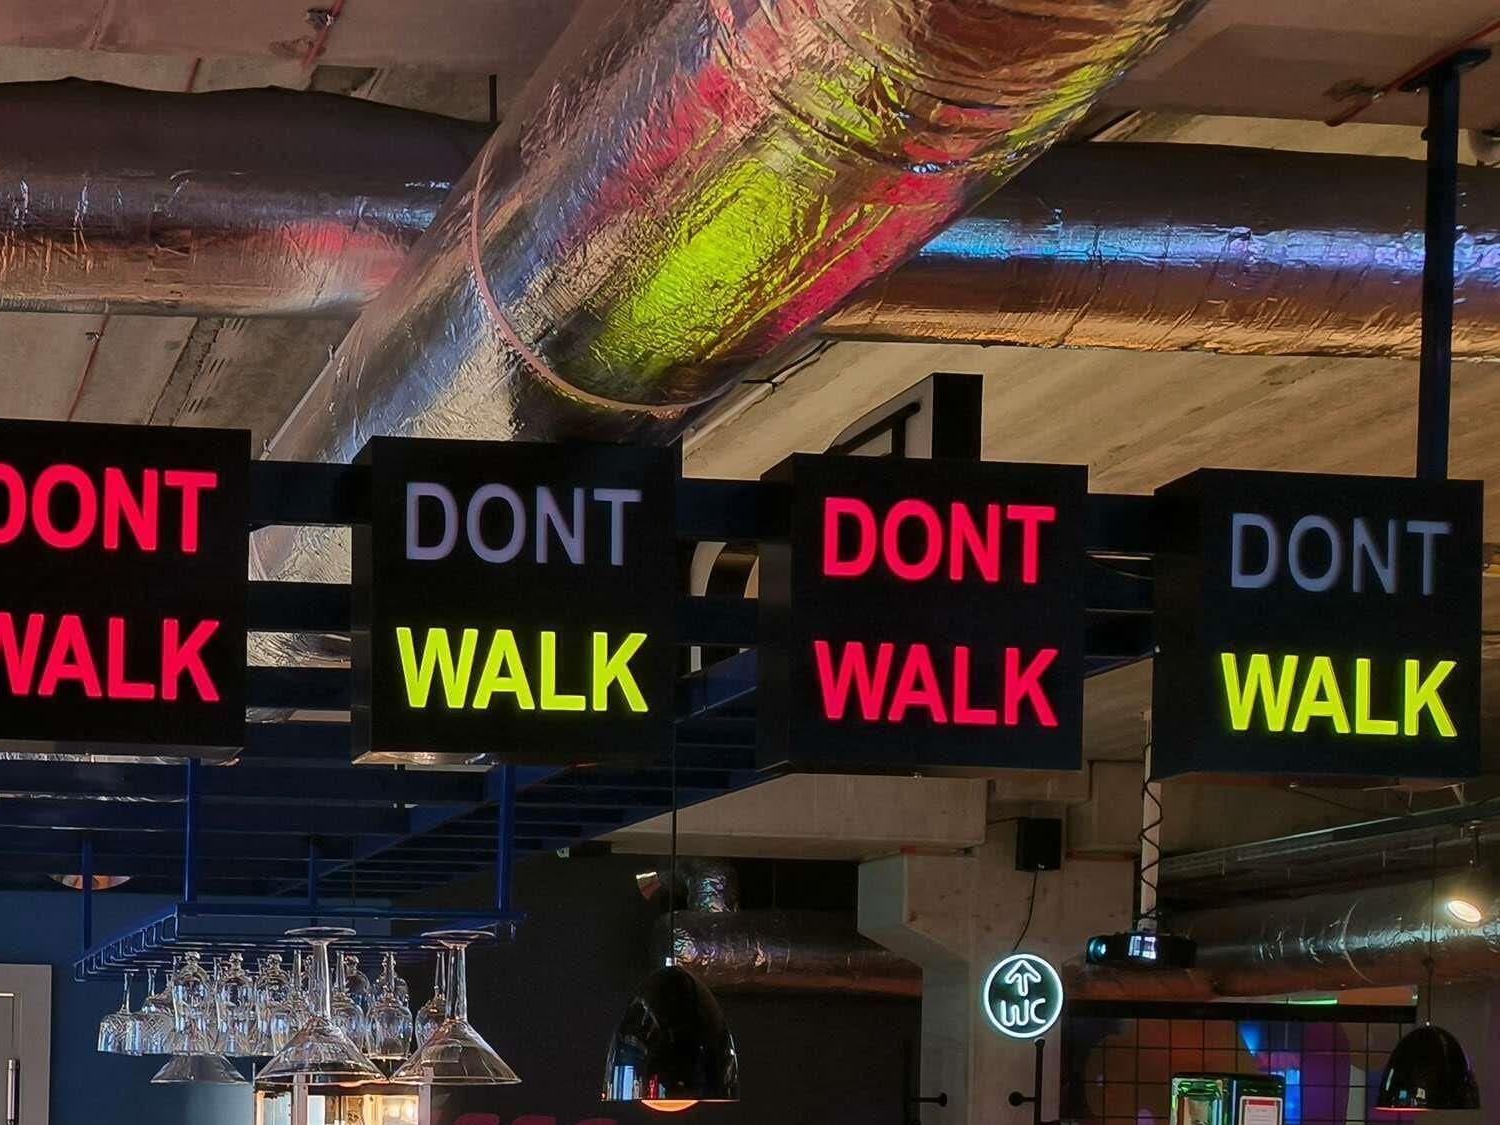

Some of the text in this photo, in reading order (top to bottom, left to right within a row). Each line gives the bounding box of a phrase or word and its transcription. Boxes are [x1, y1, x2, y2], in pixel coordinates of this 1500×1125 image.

[407, 483, 640, 565] DONT
[824, 498, 1055, 583] DONT
[1232, 514, 1448, 594] DONT
[396, 627, 648, 712] WALK
[815, 641, 1057, 726] WALK
[1221, 653, 1457, 736] WALK
[1000, 998, 1046, 1027] WC
